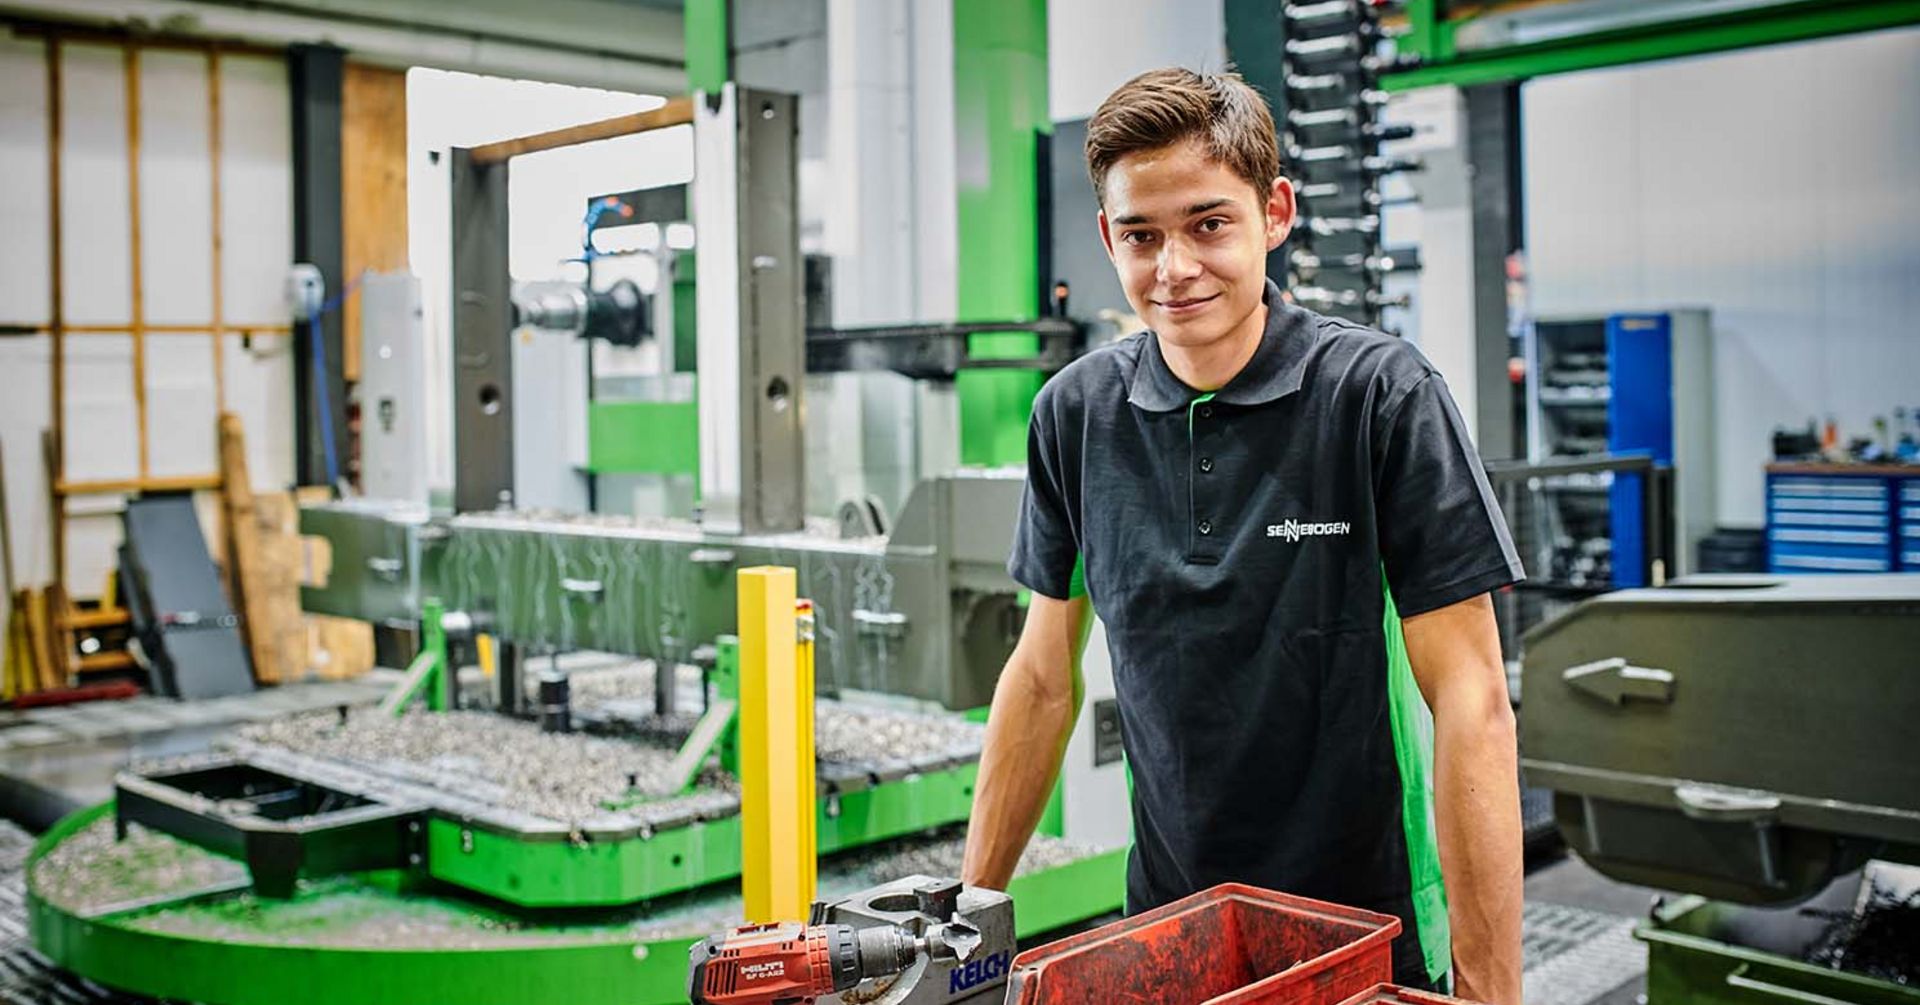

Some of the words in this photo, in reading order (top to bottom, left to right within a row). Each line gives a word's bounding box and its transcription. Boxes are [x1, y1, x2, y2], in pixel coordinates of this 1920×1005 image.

[1266, 518, 1351, 543] SENNEBOGEN
[740, 961, 784, 974] HILTI
[949, 949, 1009, 995] KELCH
